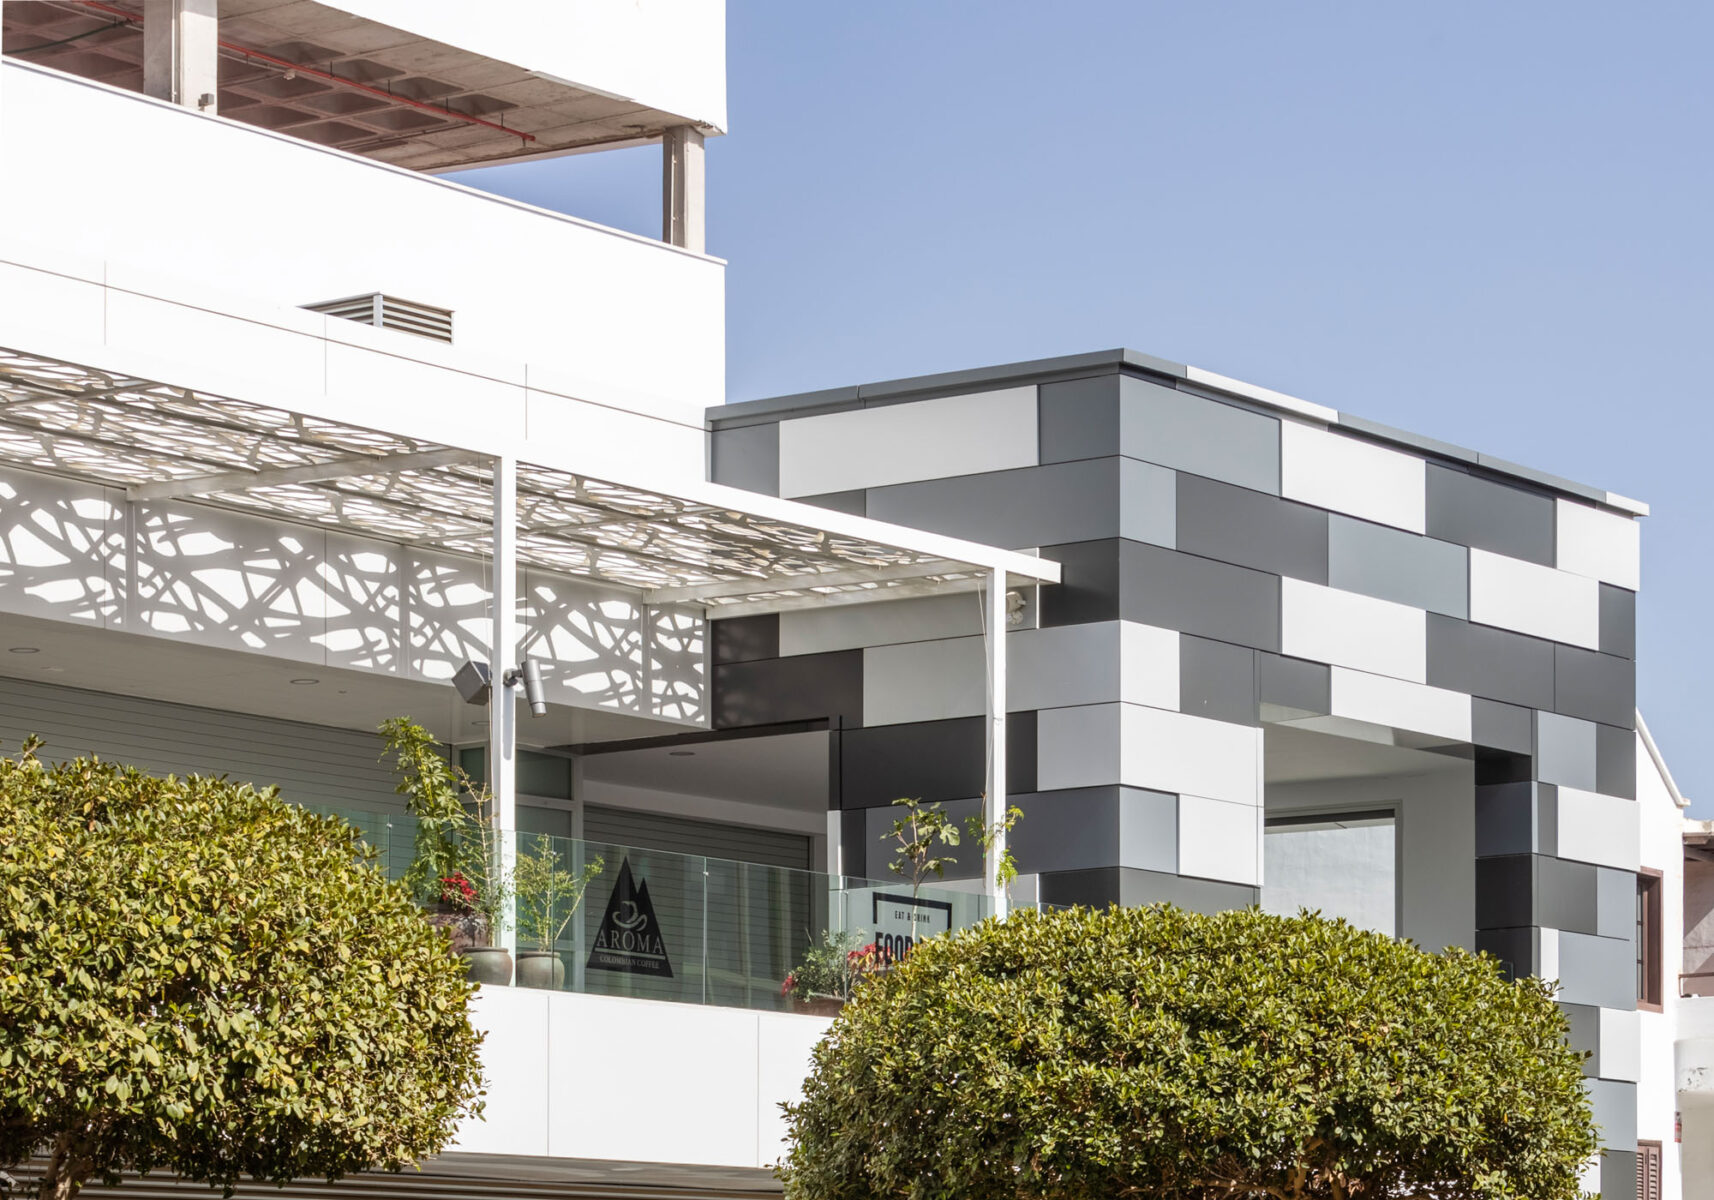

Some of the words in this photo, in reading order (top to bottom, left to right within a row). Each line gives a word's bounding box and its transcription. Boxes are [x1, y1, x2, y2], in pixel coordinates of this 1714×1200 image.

[894, 910, 905, 920] EAT
[597, 929, 664, 955] AROMA
[600, 955, 636, 967] COLOMBIAN
[637, 959, 660, 969] COFFEE
